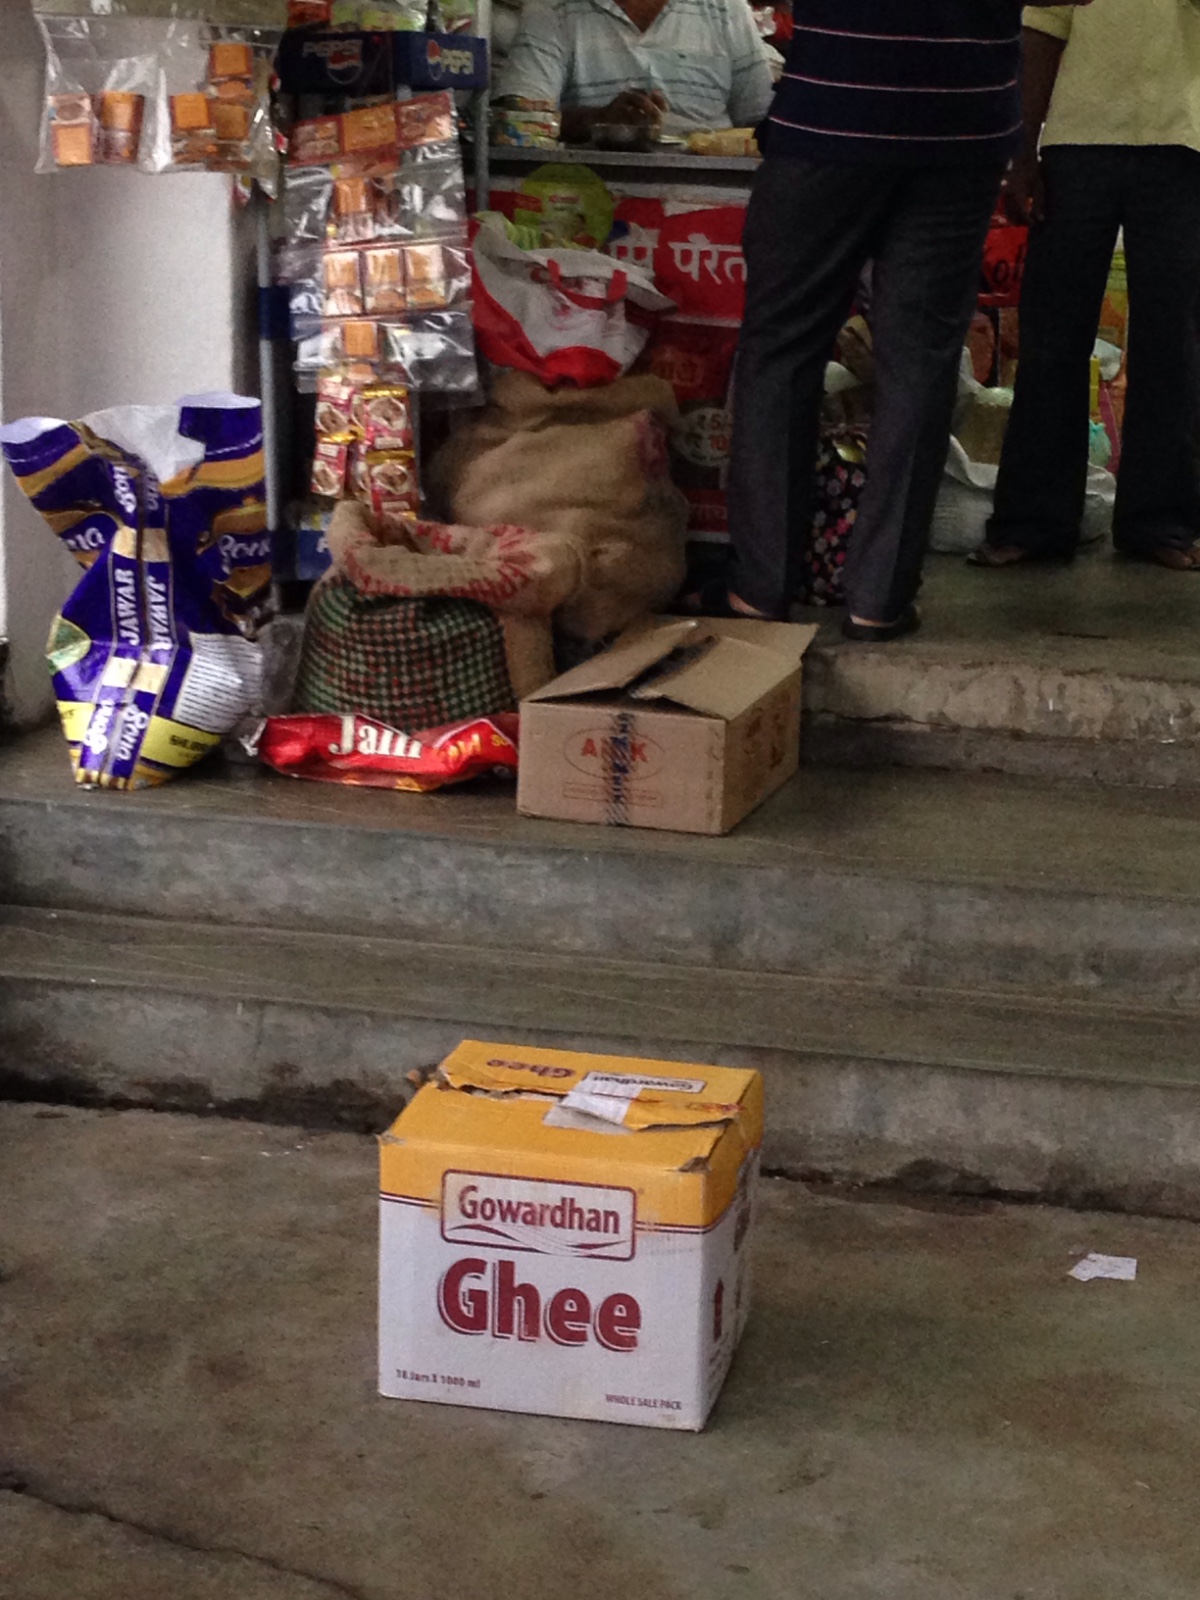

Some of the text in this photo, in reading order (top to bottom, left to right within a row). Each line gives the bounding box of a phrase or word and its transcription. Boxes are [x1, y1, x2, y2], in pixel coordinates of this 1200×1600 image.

[115, 567, 140, 647] JAWAR
[148, 575, 173, 651] JAWAR
[486, 1058, 577, 1079] Ghee
[458, 1184, 621, 1235] Gowardhan
[438, 1257, 643, 1353] Ghee
